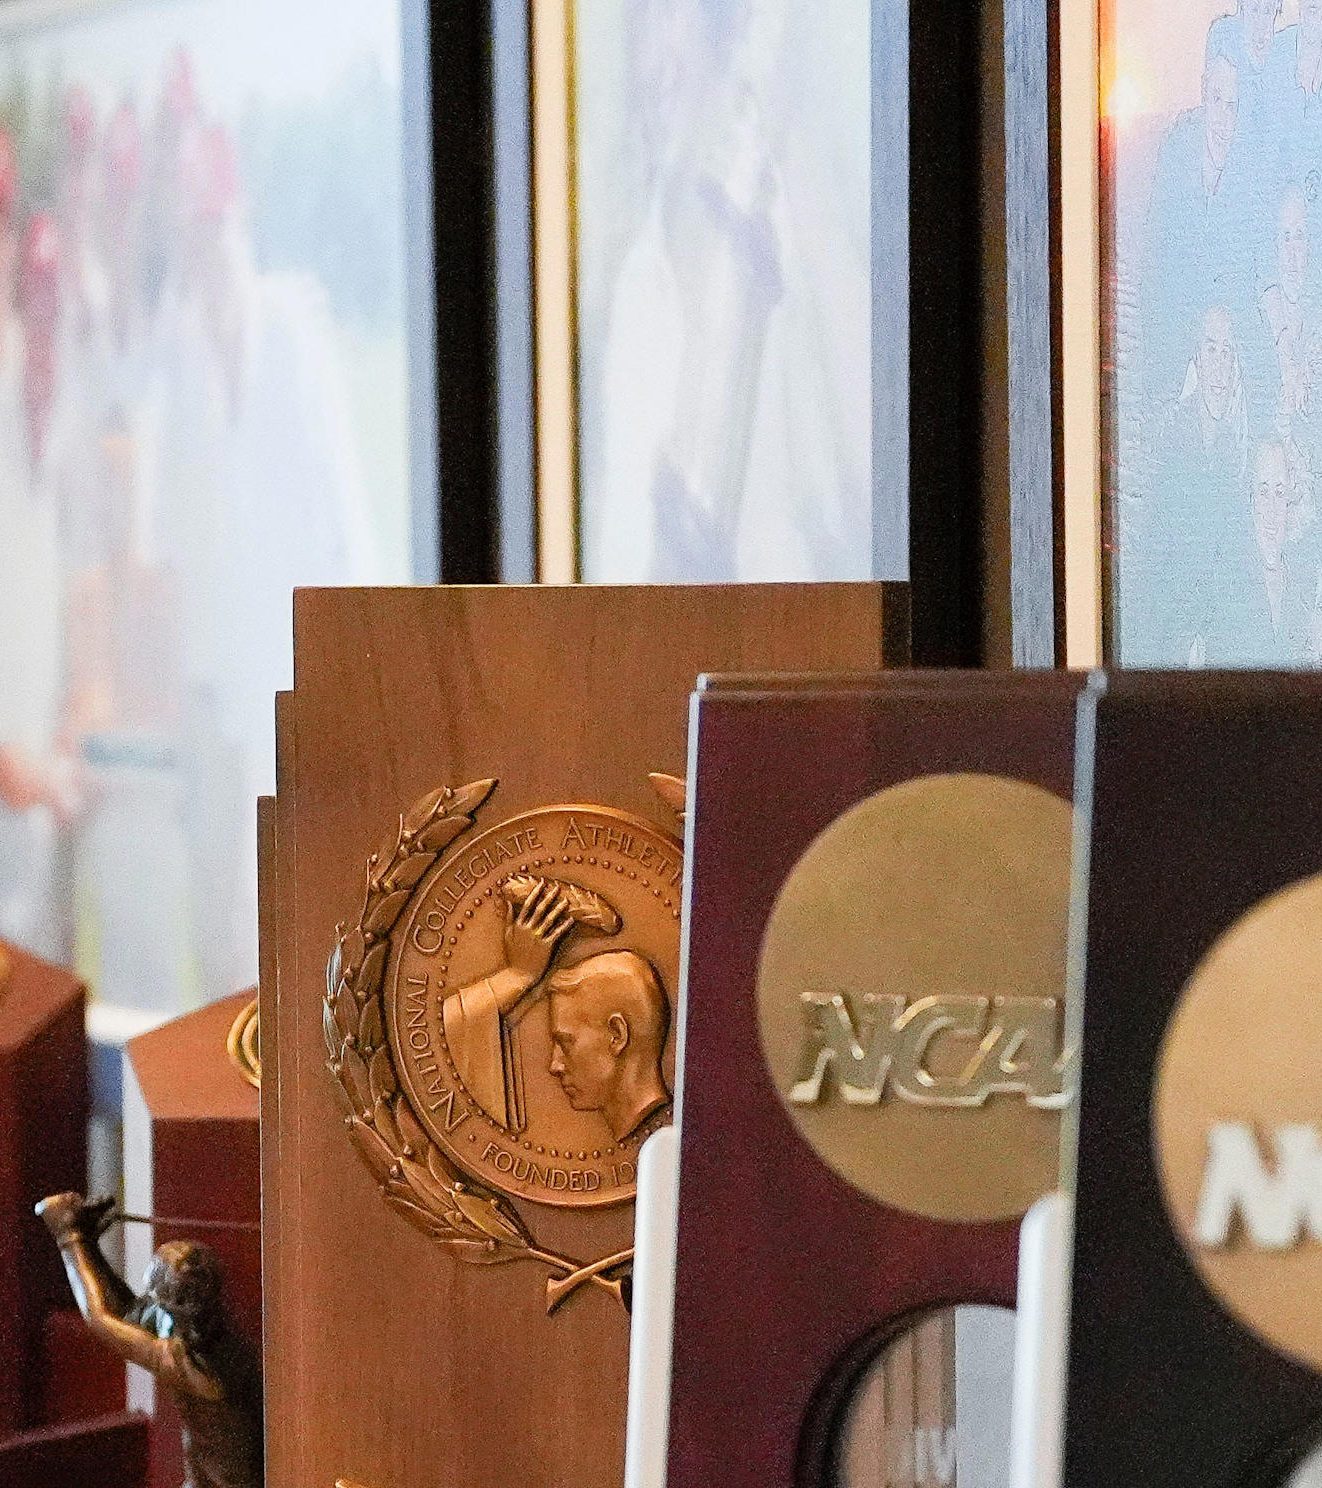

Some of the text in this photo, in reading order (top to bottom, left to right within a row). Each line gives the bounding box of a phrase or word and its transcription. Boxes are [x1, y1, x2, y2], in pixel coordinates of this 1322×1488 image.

[412, 827, 543, 955] COLLEGIATE
[406, 970, 472, 1134] NATIONAL
[479, 1141, 601, 1193] FOUNDED
